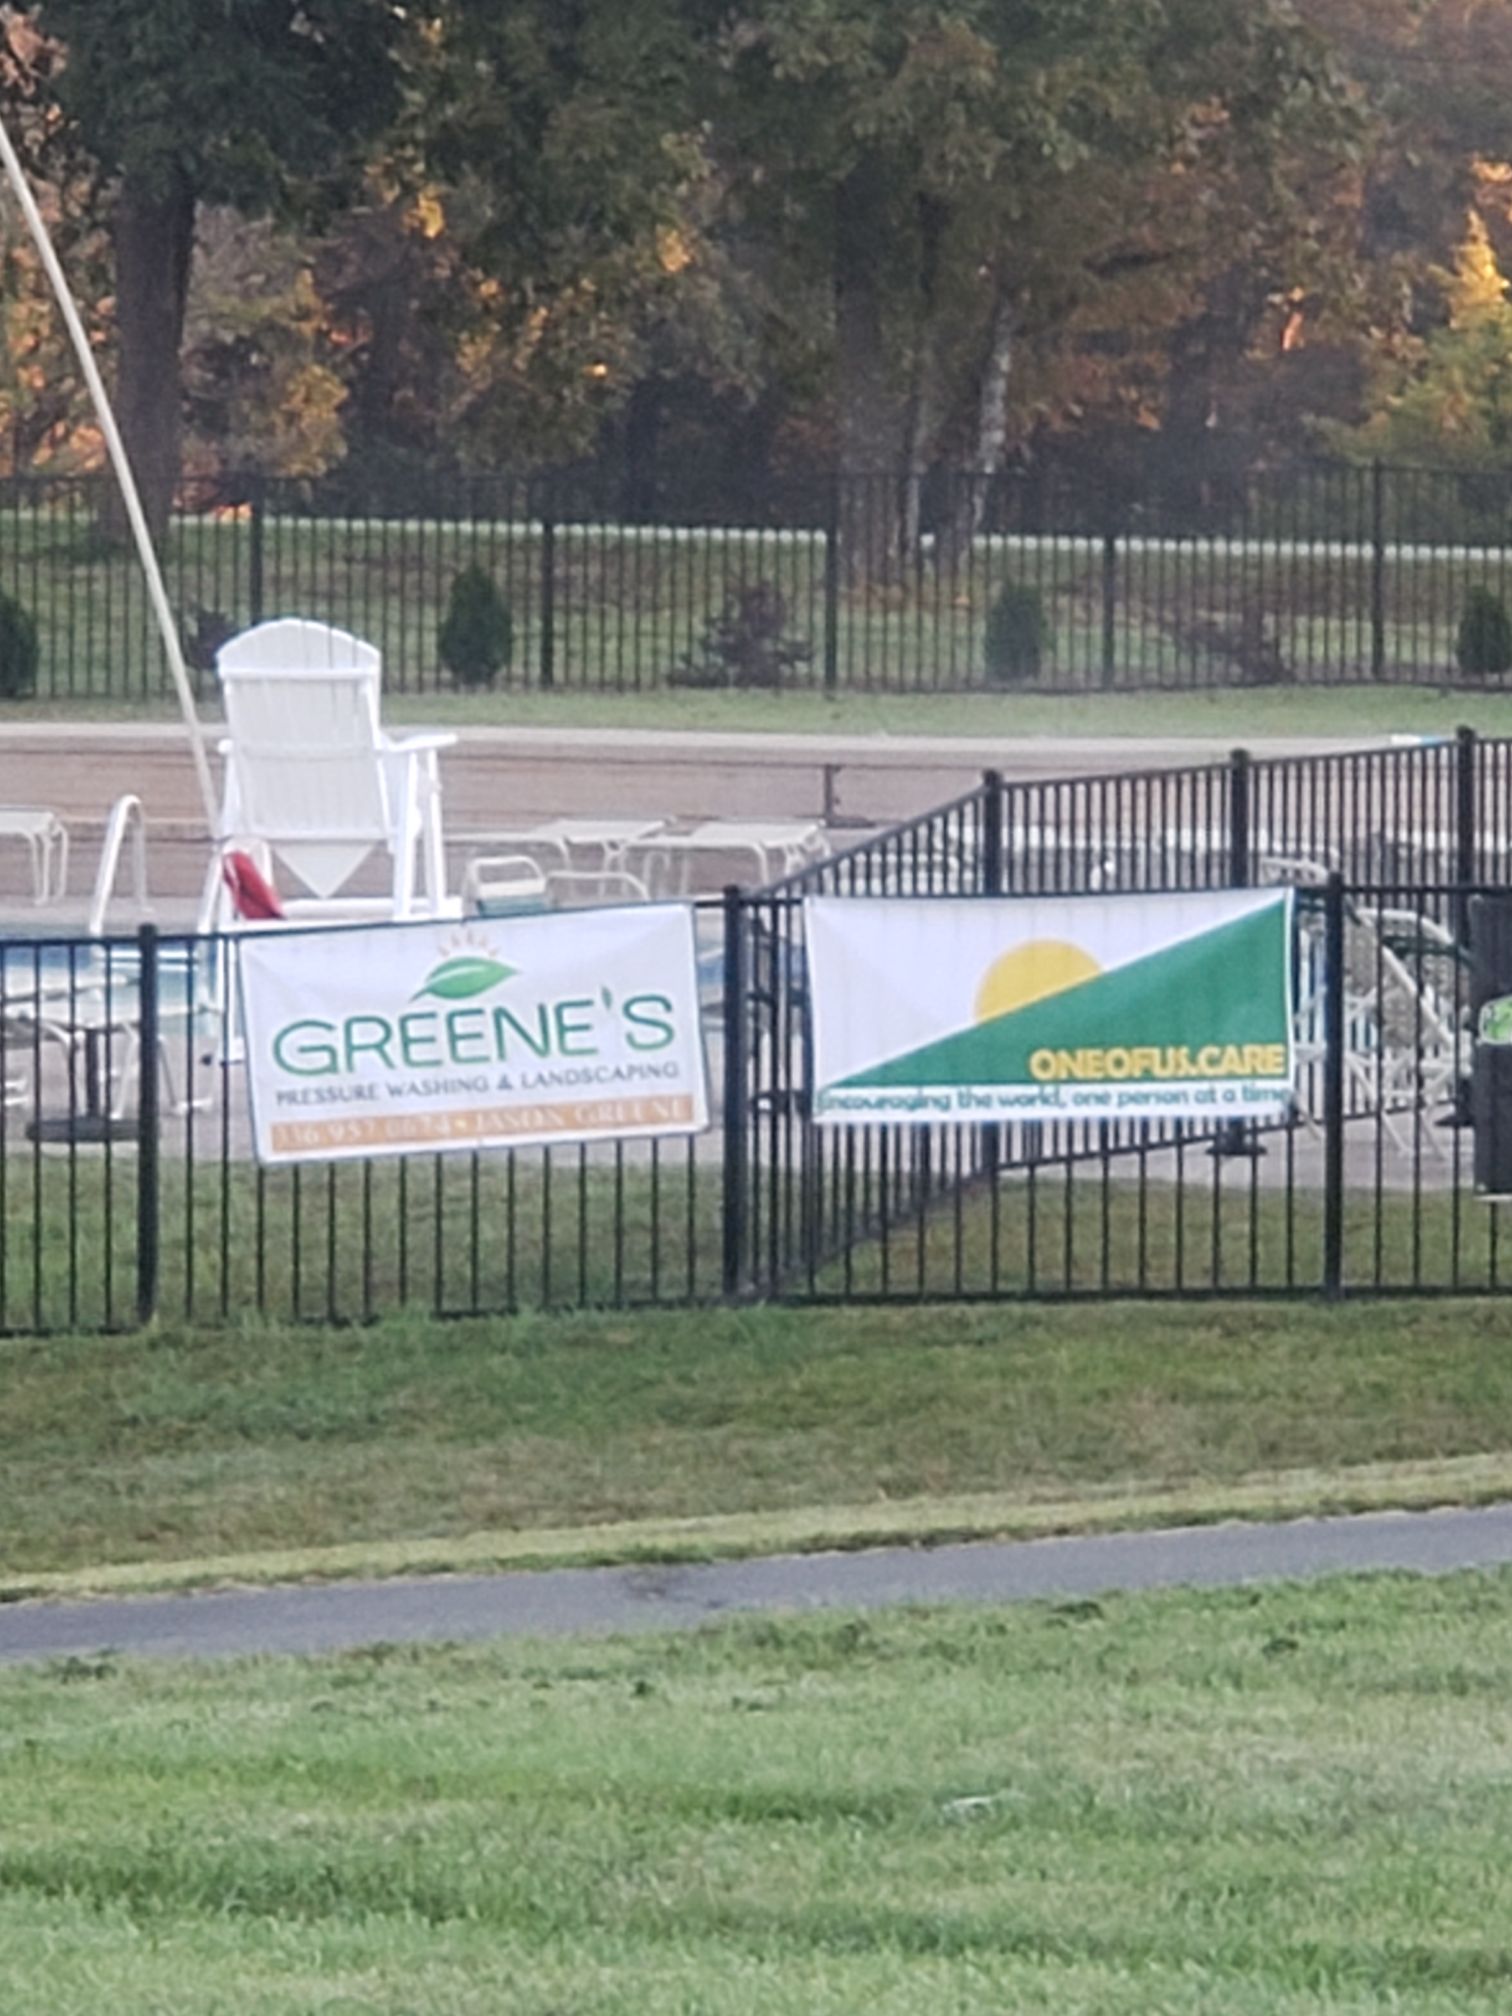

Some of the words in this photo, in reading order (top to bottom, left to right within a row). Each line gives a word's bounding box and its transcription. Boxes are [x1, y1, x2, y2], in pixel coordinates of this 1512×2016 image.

[273, 986, 676, 1077] GREENE'S
[276, 1083, 378, 1107] PRESSURE
[387, 1075, 490, 1098] WASHING
[497, 1073, 514, 1091] &
[521, 1062, 679, 1090] LANDSCAPING
[959, 1086, 993, 1109] the
[998, 1086, 1067, 1109] world,
[1072, 1090, 1112, 1107] one
[1117, 1089, 1189, 1109] person
[1194, 1086, 1218, 1105] at
[1222, 1088, 1237, 1103] a
